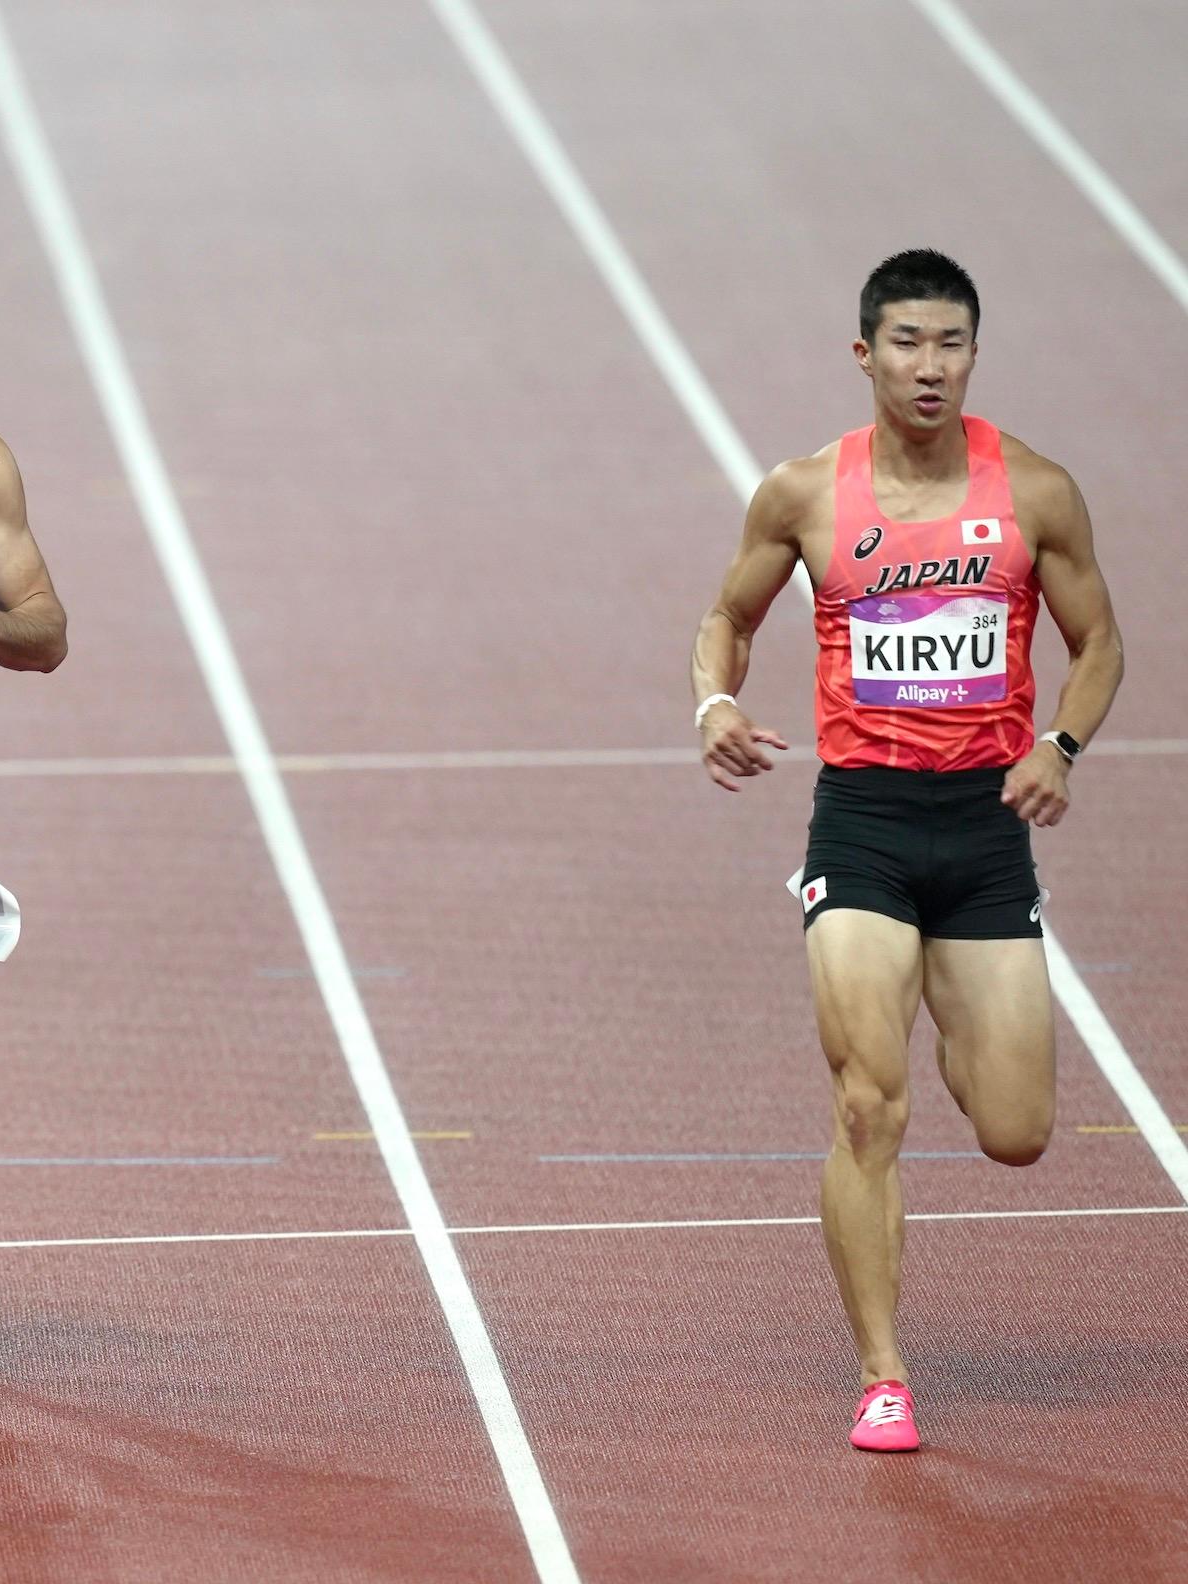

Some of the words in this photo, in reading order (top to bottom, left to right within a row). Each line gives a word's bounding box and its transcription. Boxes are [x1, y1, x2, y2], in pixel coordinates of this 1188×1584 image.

[864, 555, 993, 595] JAPAN
[972, 614, 998, 630] 384
[865, 632, 995, 671] KIRYU
